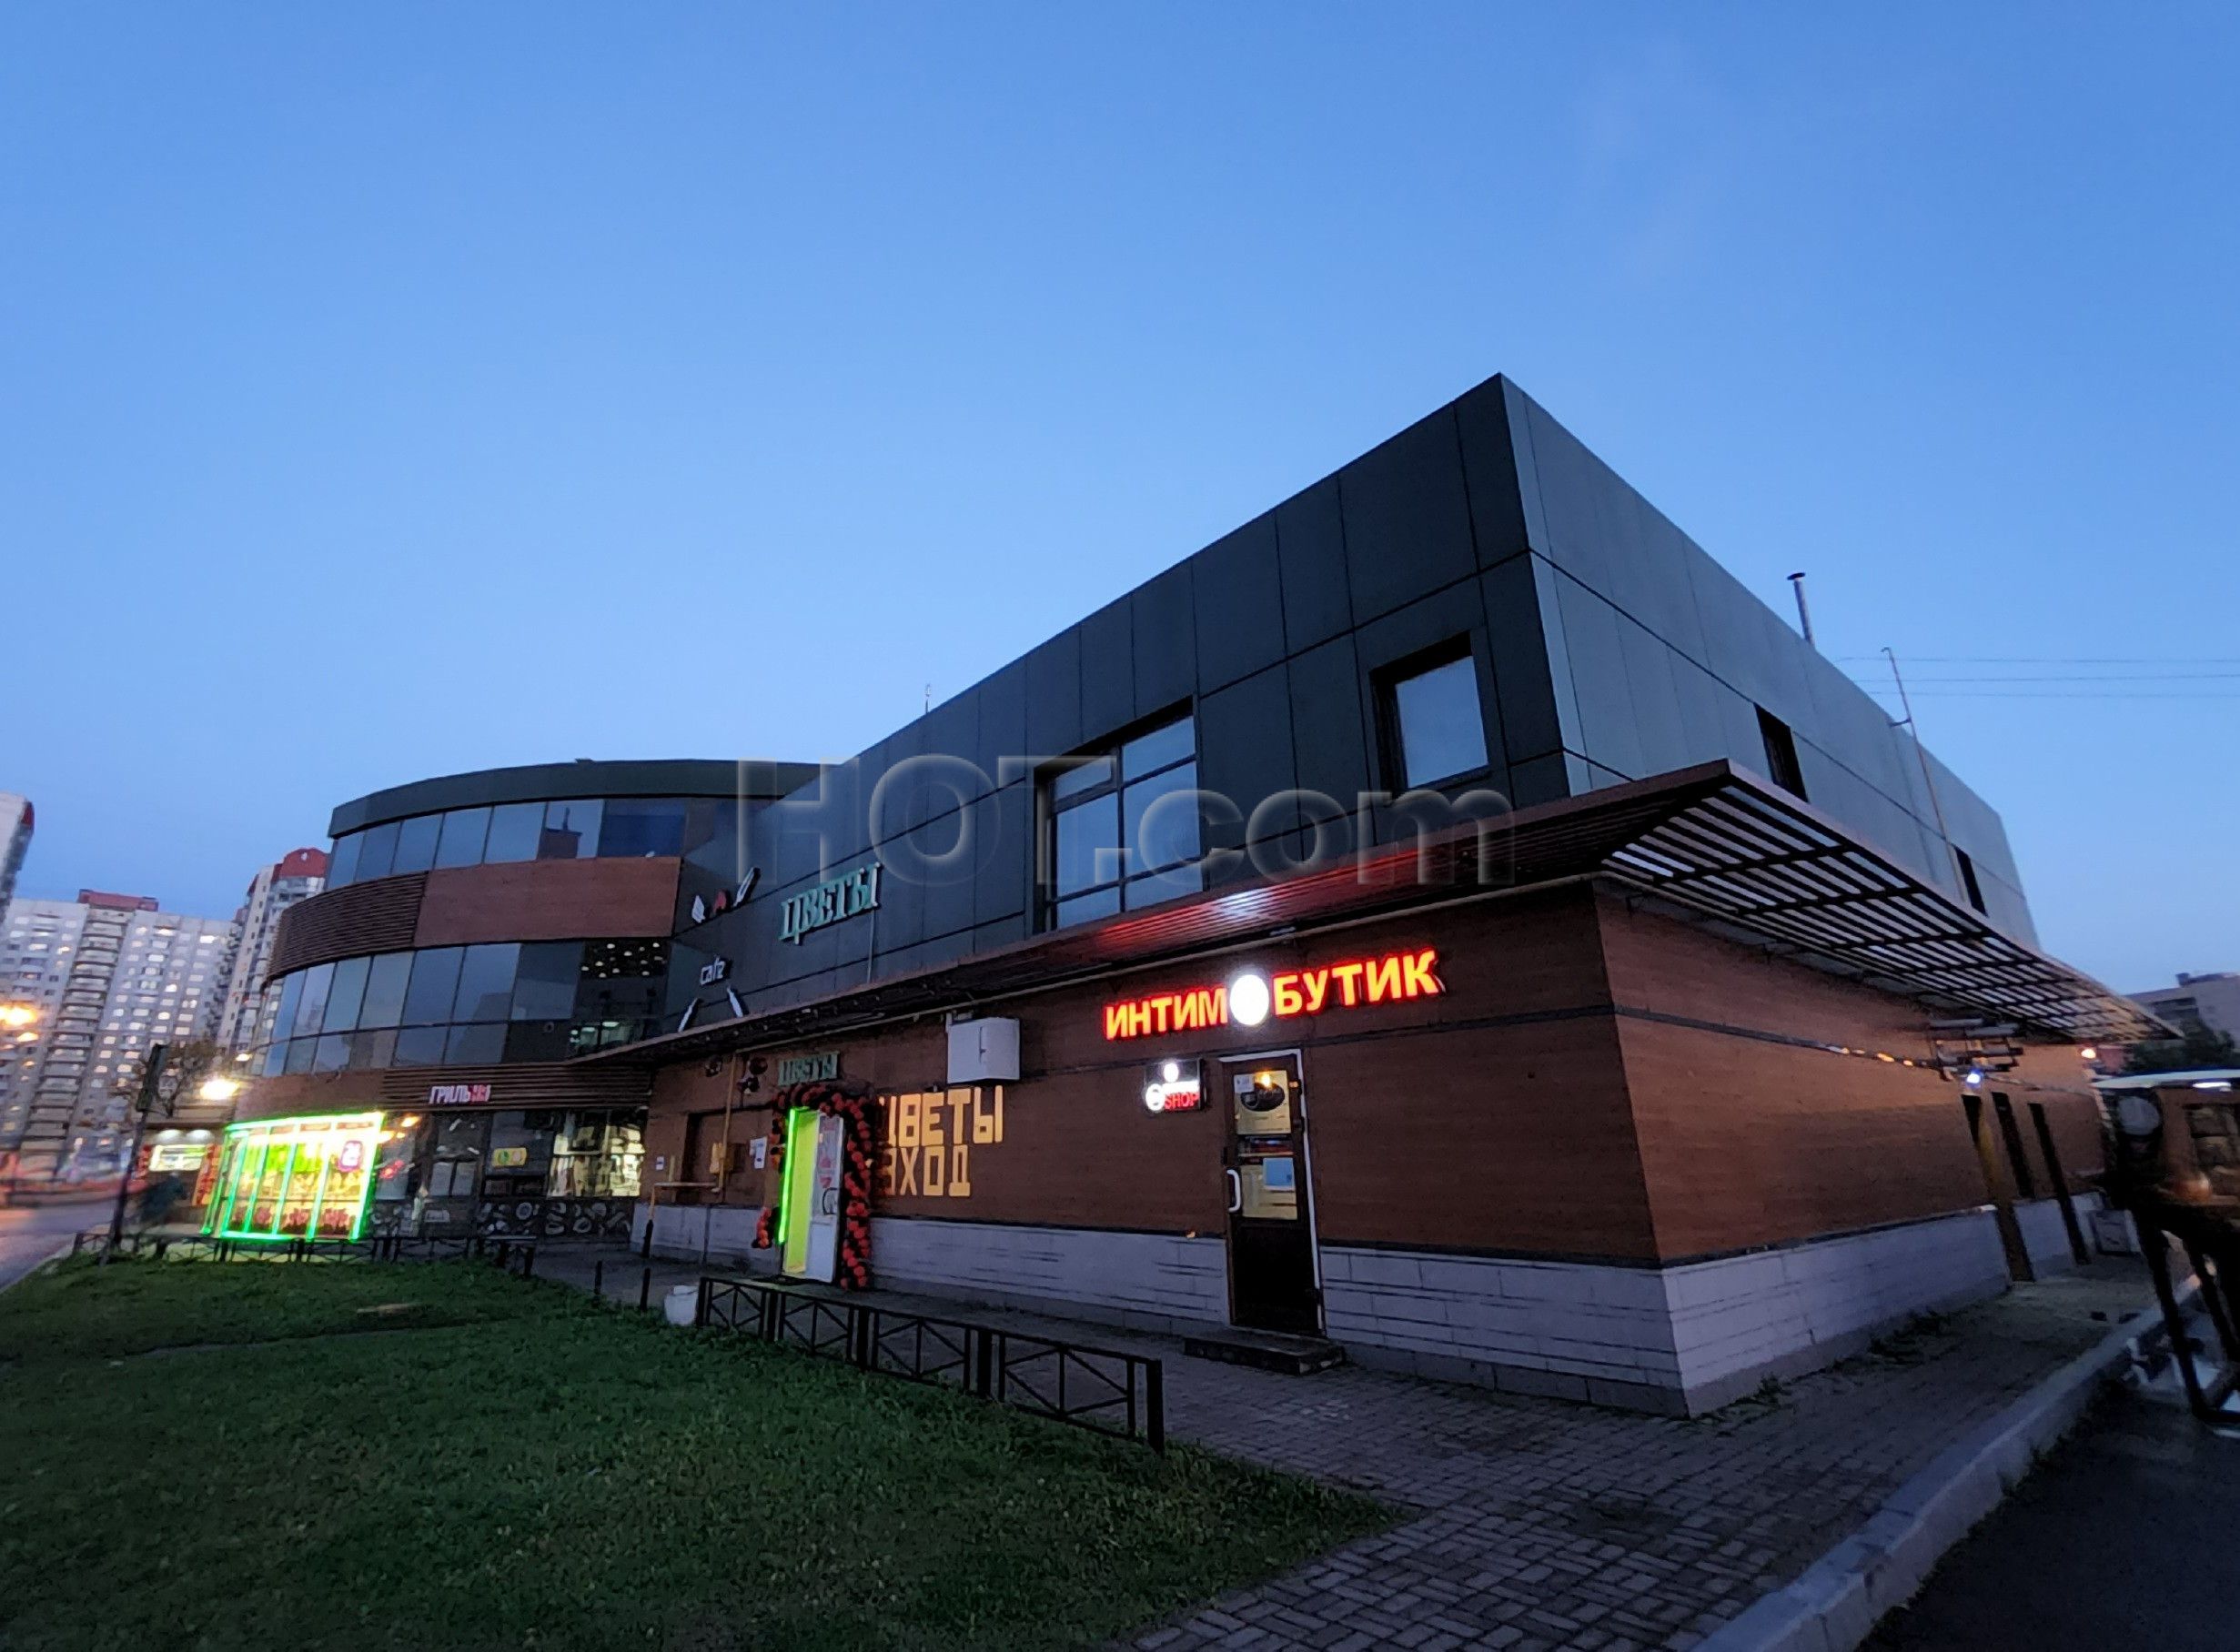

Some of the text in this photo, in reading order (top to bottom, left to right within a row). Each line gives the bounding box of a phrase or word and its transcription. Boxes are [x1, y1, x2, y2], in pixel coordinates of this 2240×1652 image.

[780, 861, 881, 945] ЦВЕТЫ
[1105, 950, 1445, 1041] ИНТИМ БУТИК
[1165, 1092, 1199, 1110] SHOP
